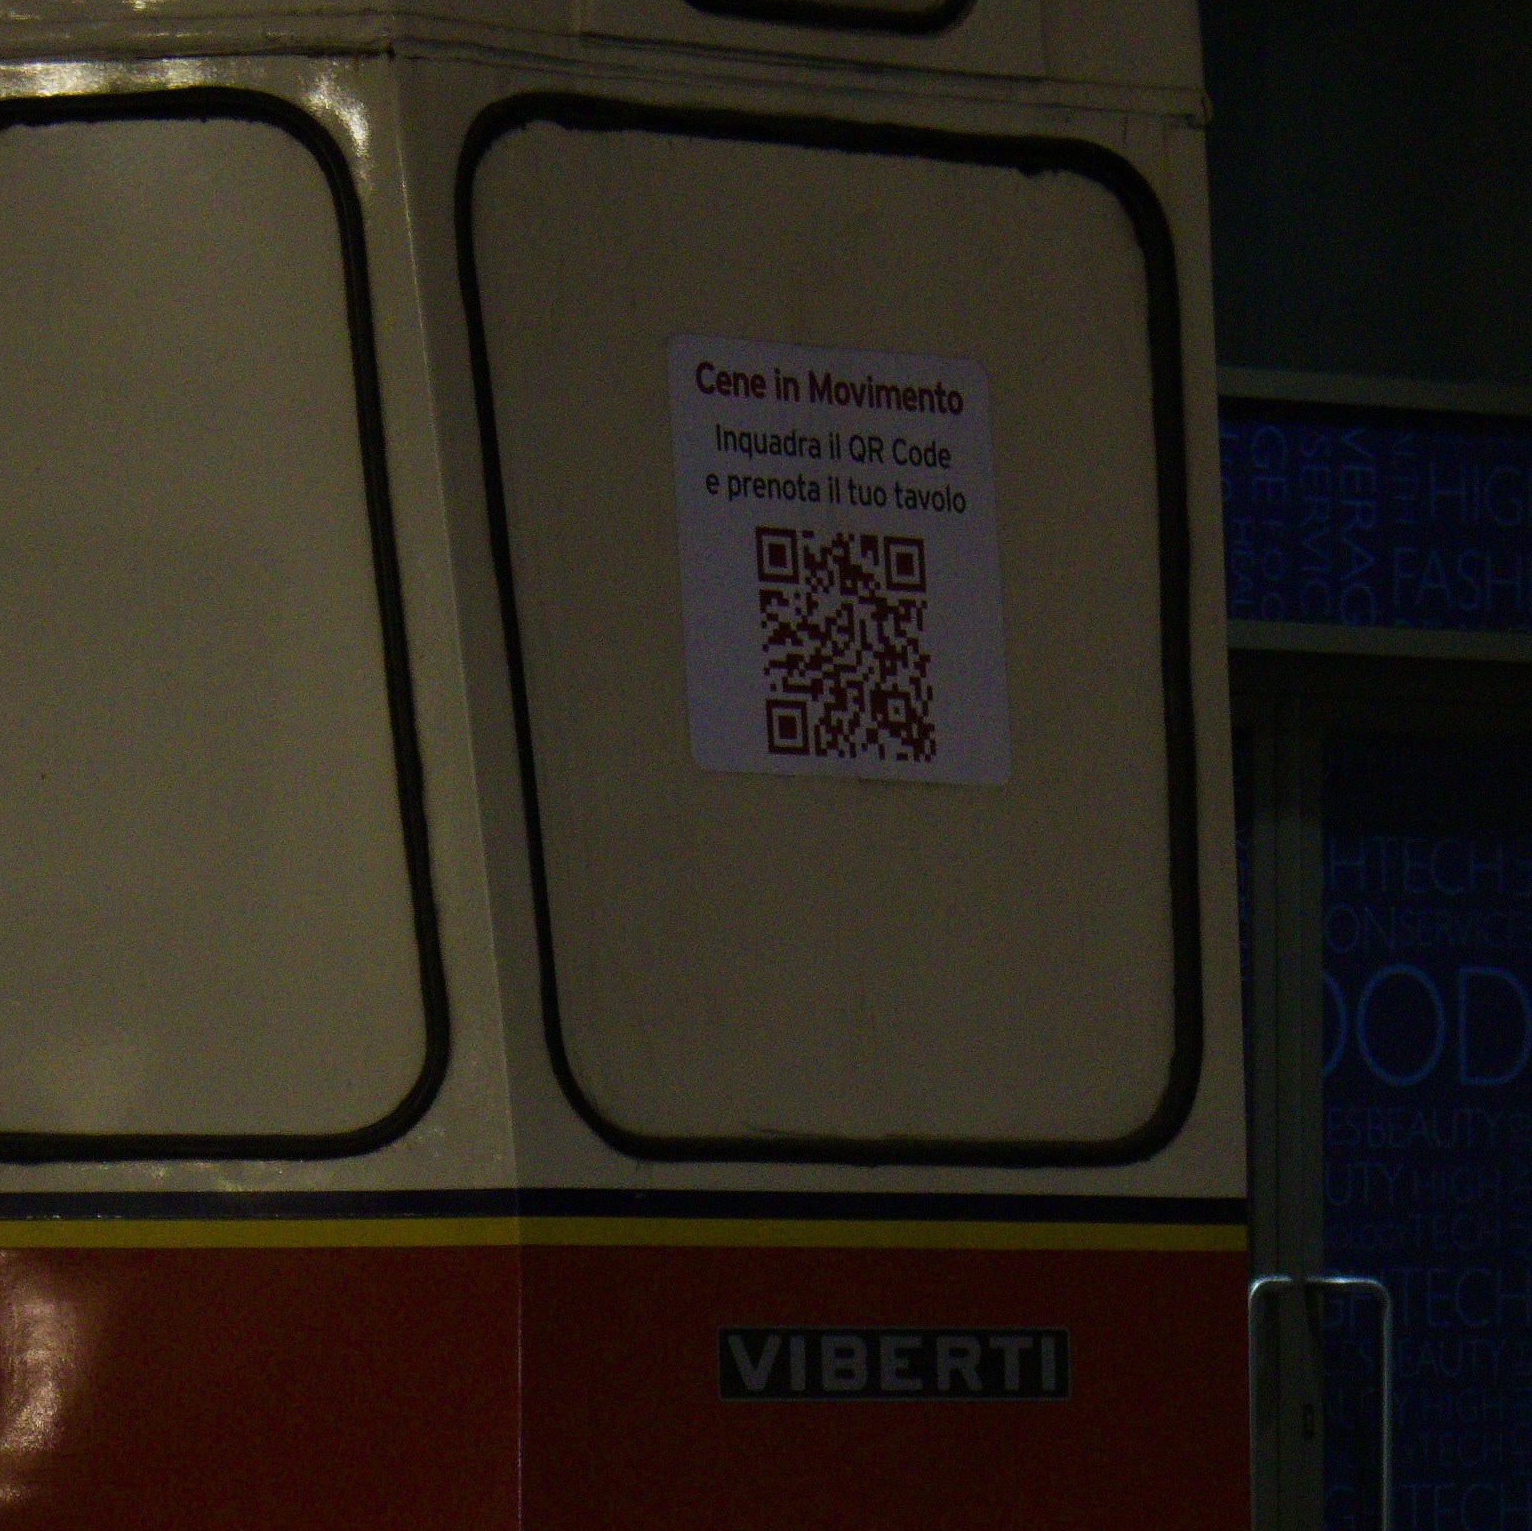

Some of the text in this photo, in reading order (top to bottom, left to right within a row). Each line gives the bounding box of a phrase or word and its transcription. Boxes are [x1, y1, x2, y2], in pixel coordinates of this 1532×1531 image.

[695, 360, 964, 415] Cene in Movimento
[715, 424, 952, 469] Inquadra il QR Code
[705, 470, 967, 514] e prenota il tuo tavolo
[726, 1333, 1058, 1393] VIBERTI
